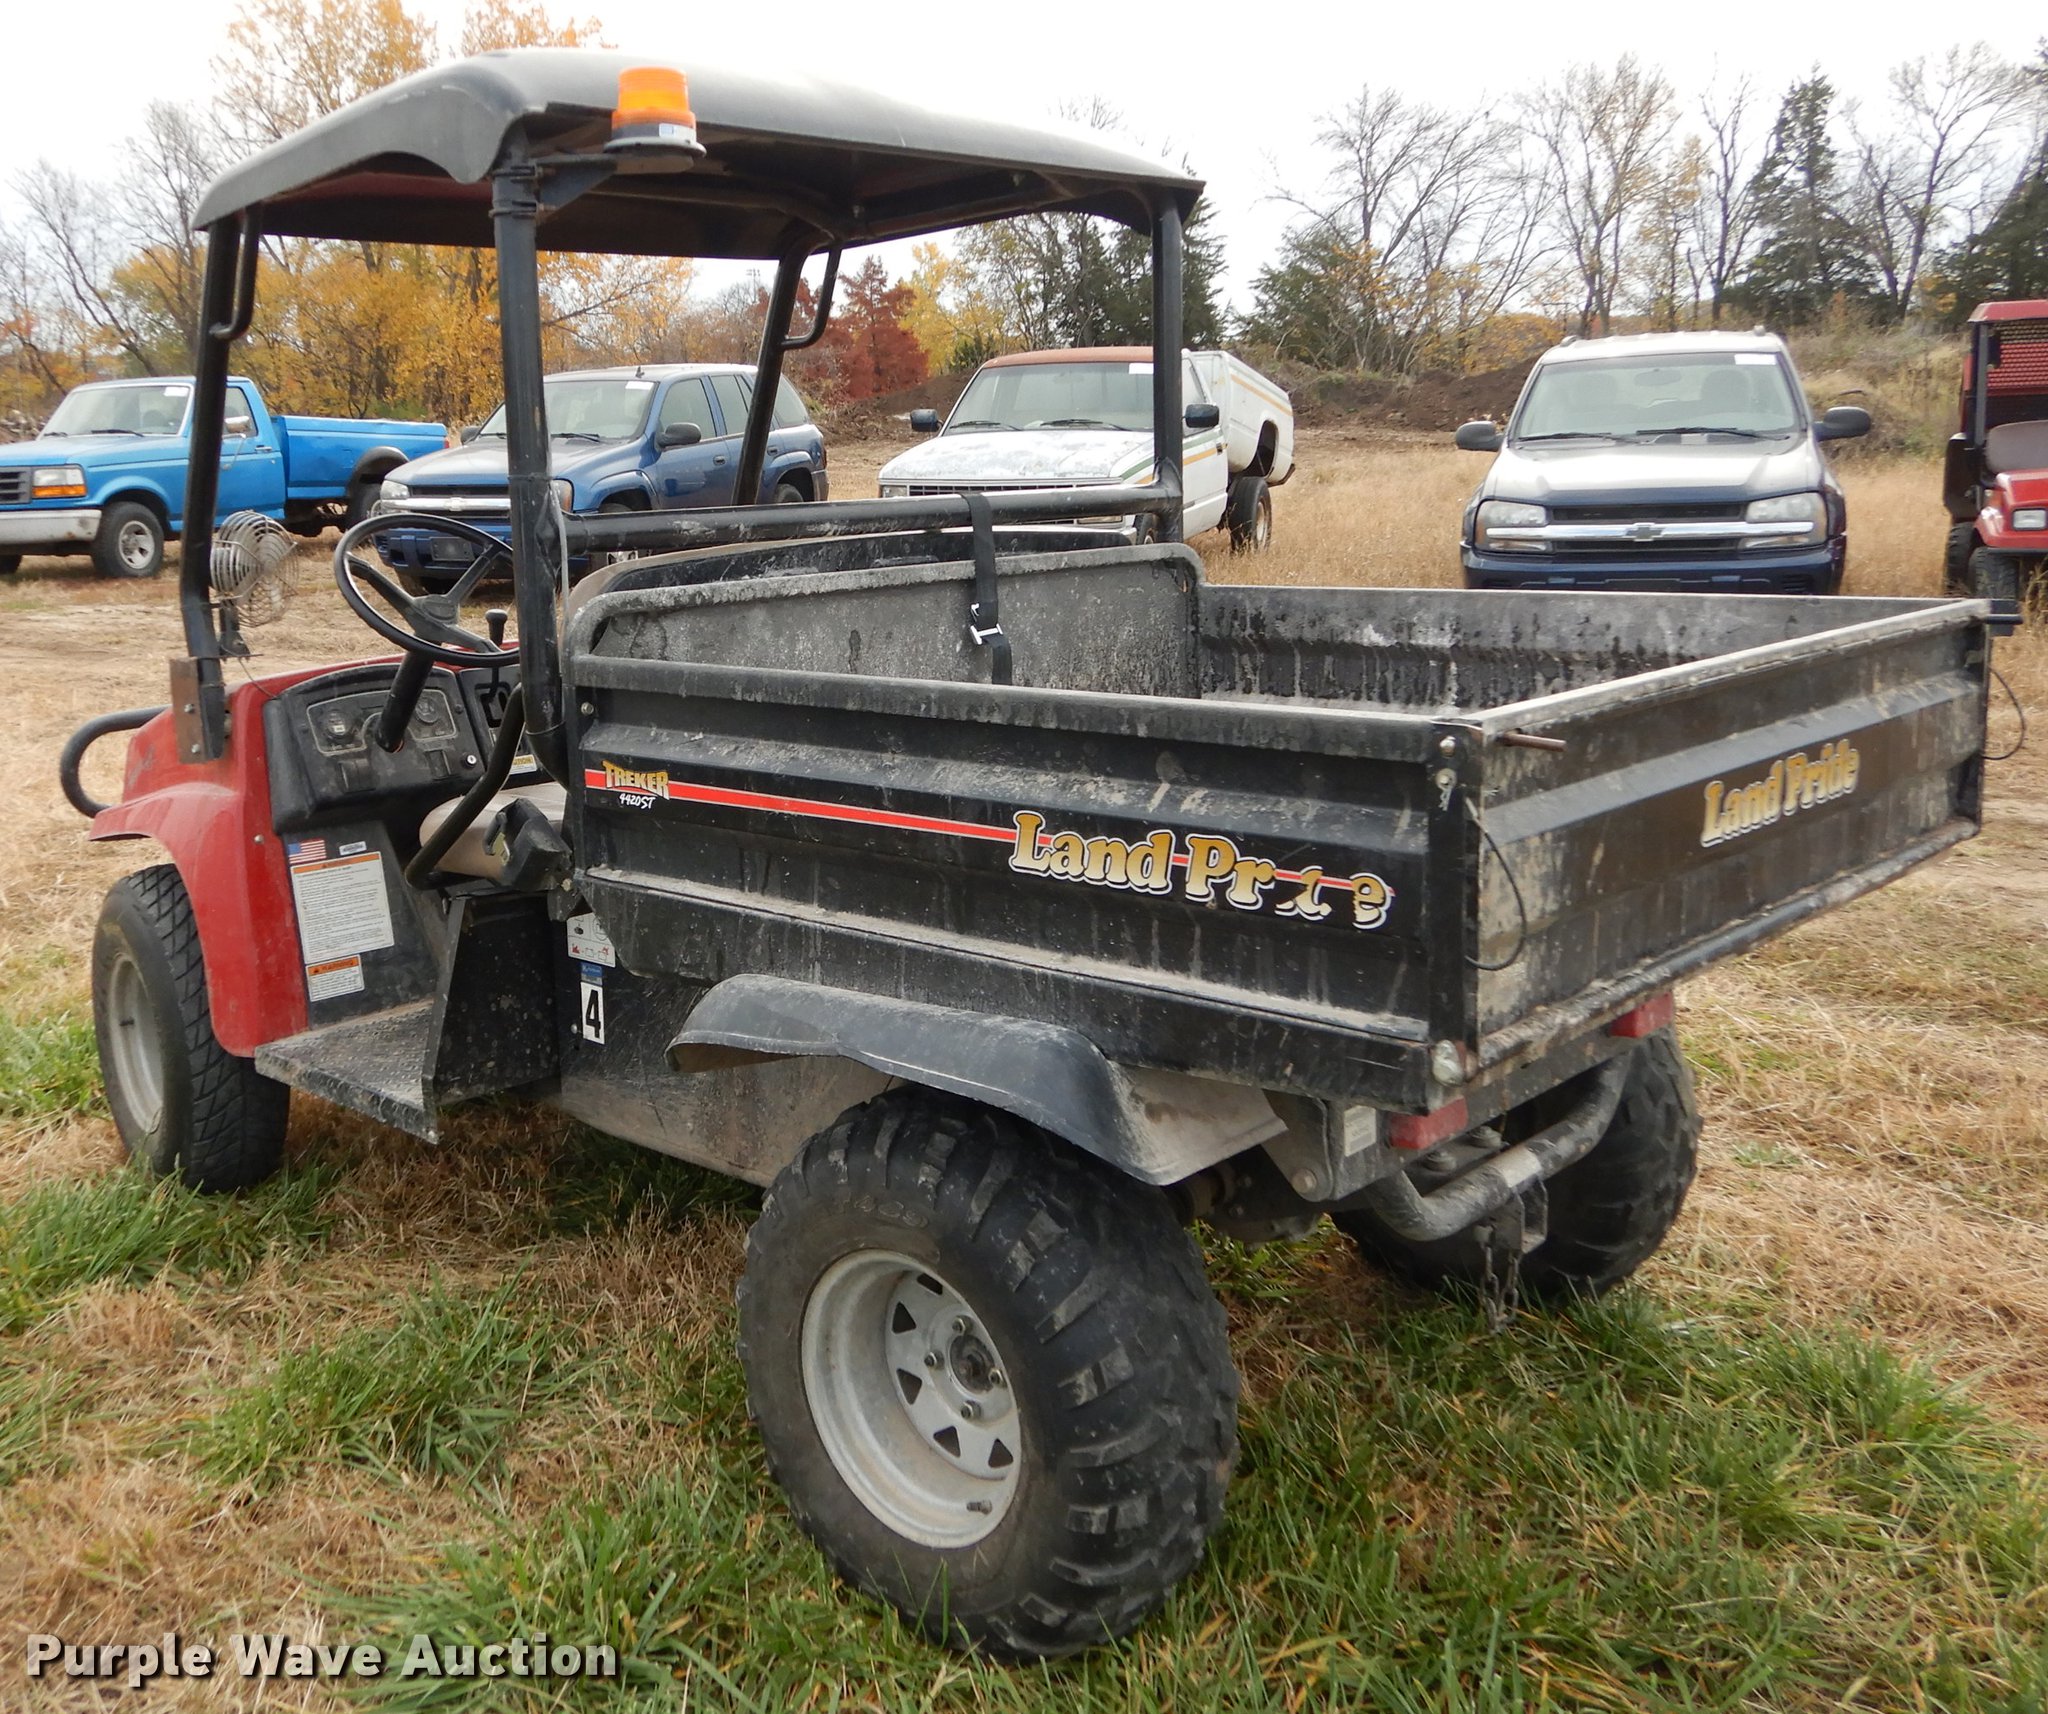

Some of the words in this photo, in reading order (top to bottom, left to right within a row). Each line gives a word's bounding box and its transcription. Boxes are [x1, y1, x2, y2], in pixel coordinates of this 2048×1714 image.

[602, 760, 670, 801] TREKER
[619, 793, 656, 810] 4420ST
[1701, 759, 1785, 848] Land
[1782, 738, 1861, 817] Pride
[1009, 809, 1176, 895] Land
[1185, 832, 1393, 929] Pre
[585, 989, 602, 1039] 4
